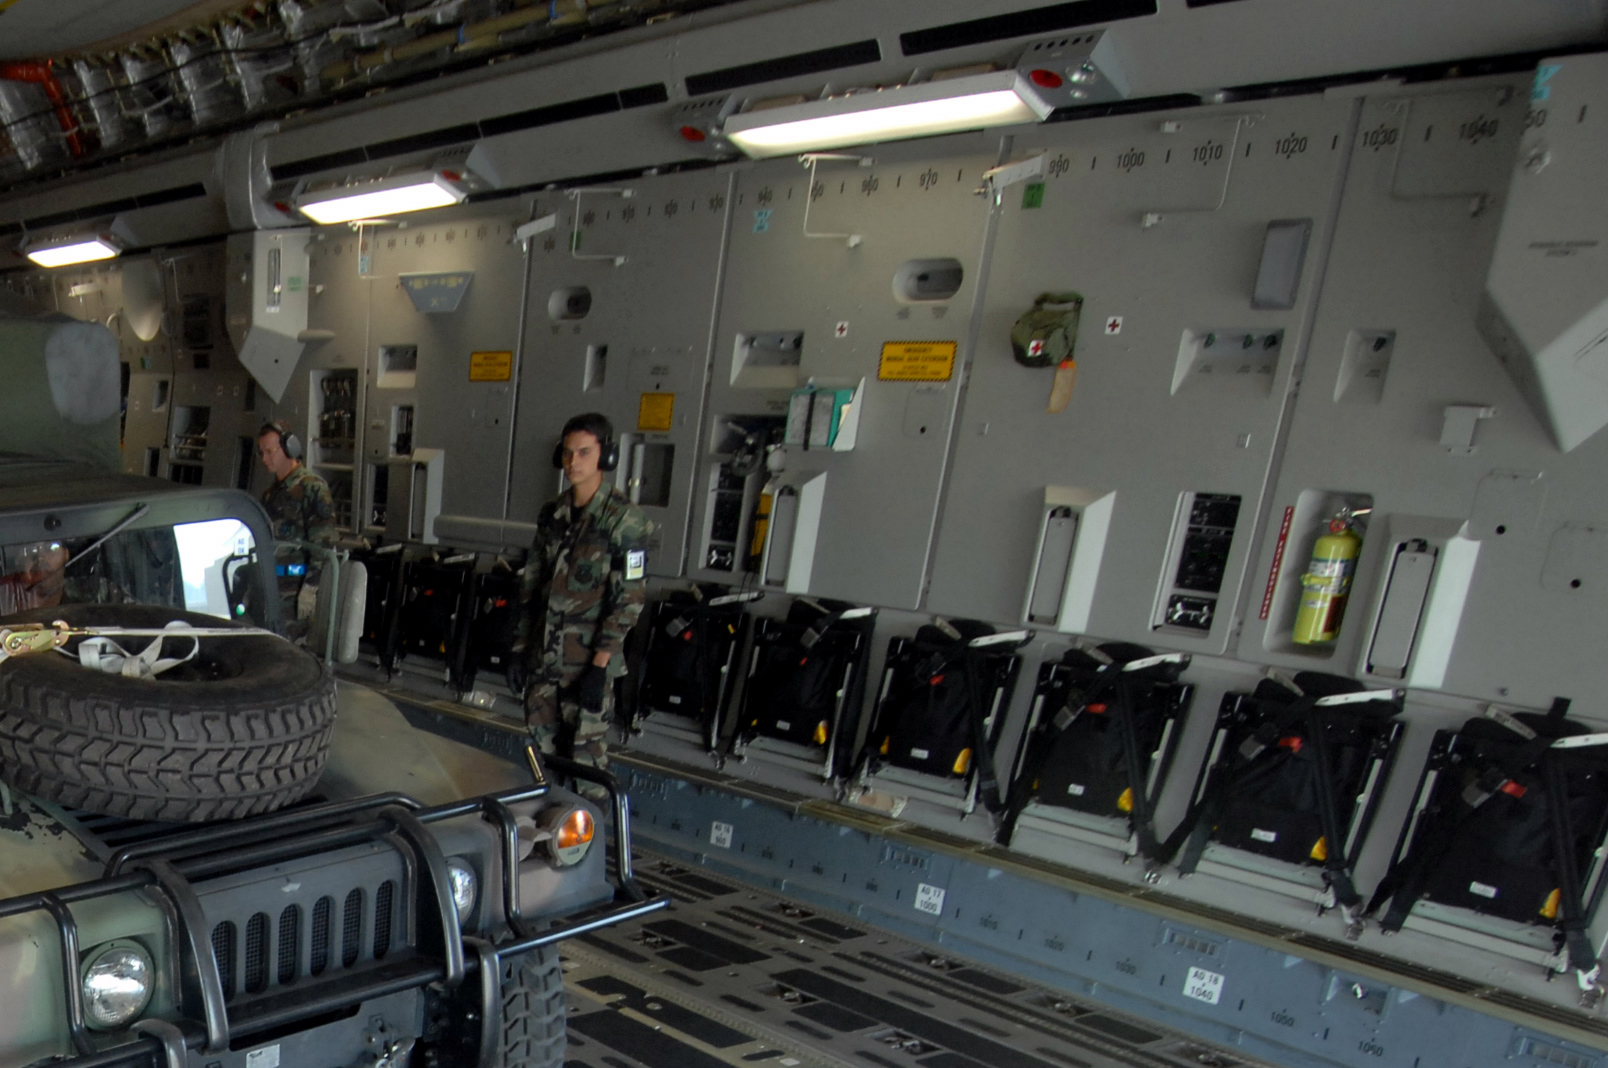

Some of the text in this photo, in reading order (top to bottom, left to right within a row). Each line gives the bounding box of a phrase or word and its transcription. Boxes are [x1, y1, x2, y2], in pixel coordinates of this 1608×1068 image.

[1275, 136, 1308, 155] 1020
[1362, 128, 1398, 147] 1030
[1117, 151, 1145, 169] 1000
[1193, 144, 1223, 161] 1010
[1049, 158, 1070, 175] 990
[919, 171, 938, 187] 970
[1192, 969, 1220, 986] AD 18
[1190, 986, 1214, 1001] 1040
